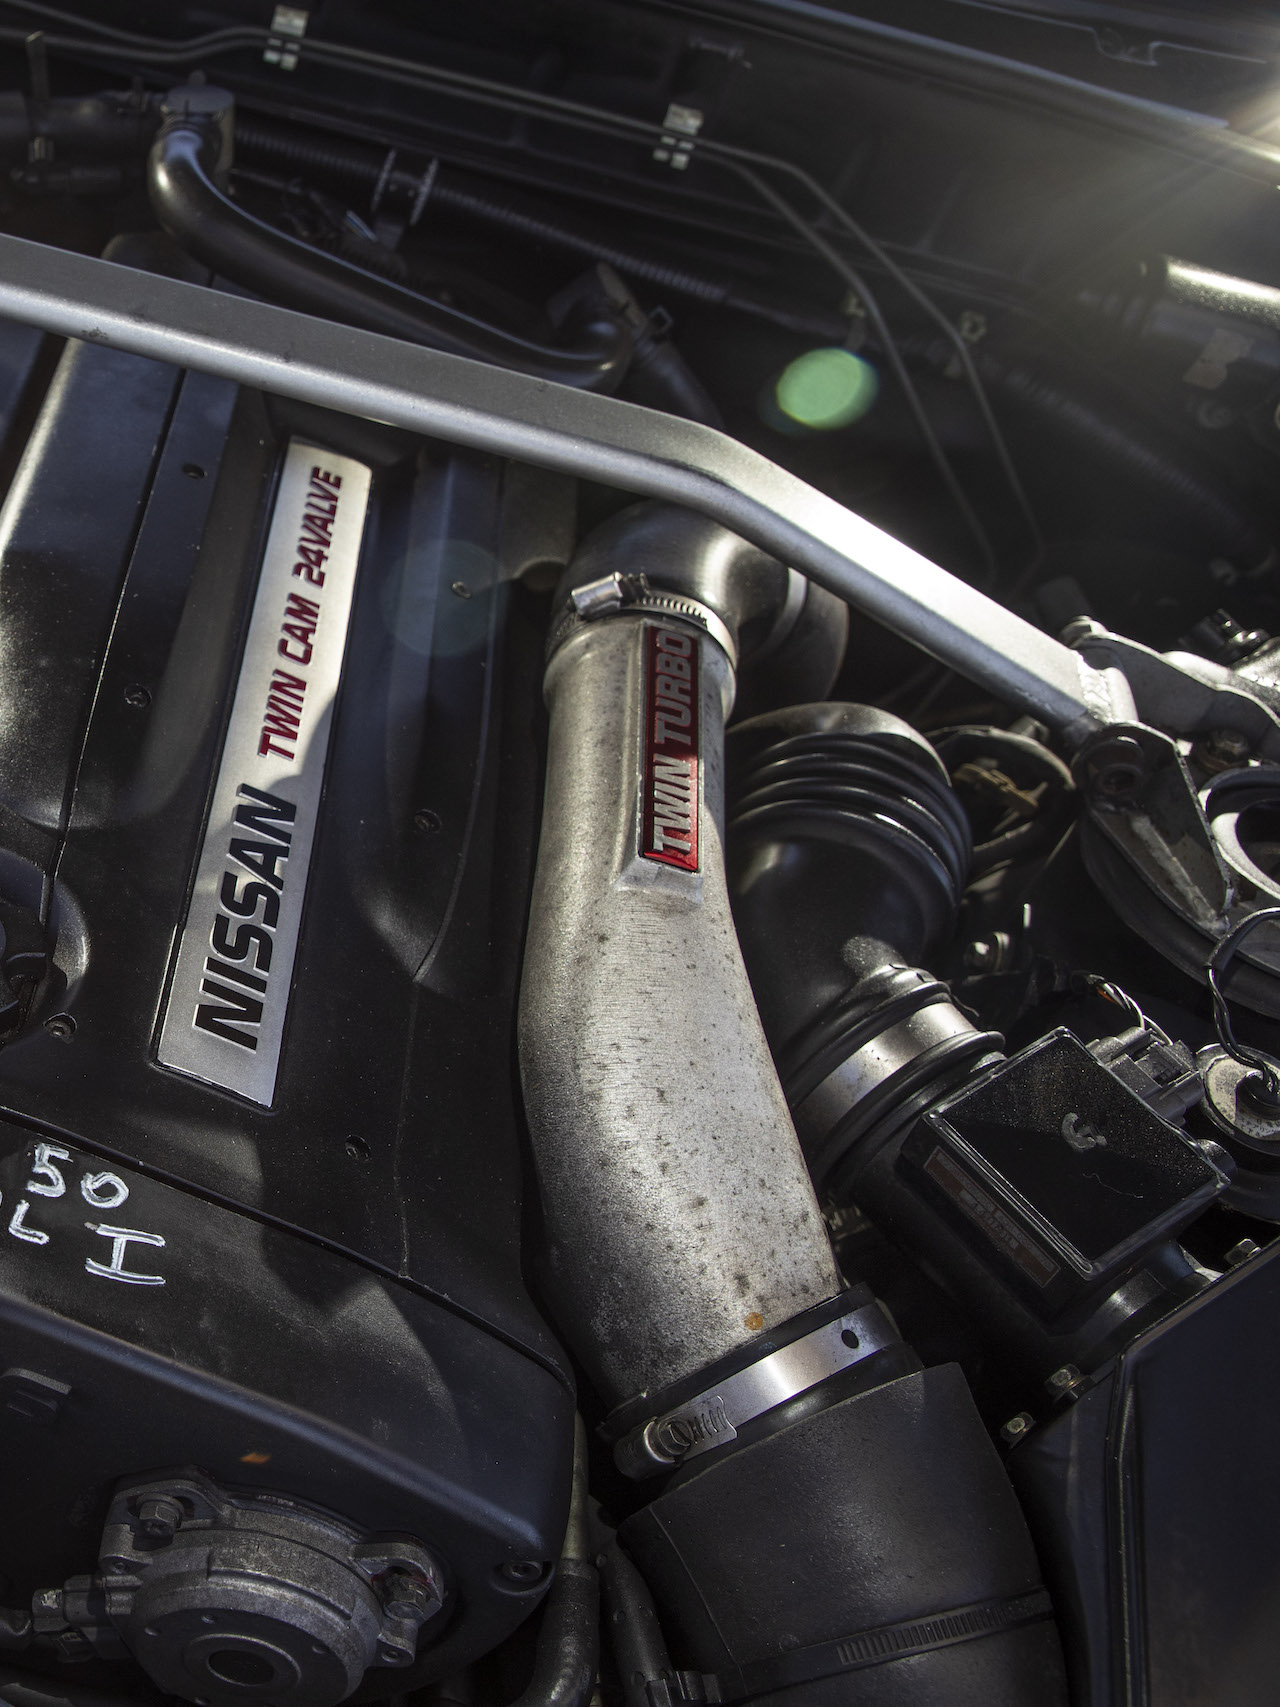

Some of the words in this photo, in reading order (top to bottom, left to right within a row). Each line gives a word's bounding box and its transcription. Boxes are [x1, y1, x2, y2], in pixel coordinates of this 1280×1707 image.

[292, 465, 343, 589] 24VALVE
[277, 592, 321, 666] CAM
[257, 668, 308, 761] TWIN
[653, 629, 693, 746] TURBO
[652, 752, 692, 853] TWIN
[192, 782, 297, 1056] NISSAN
